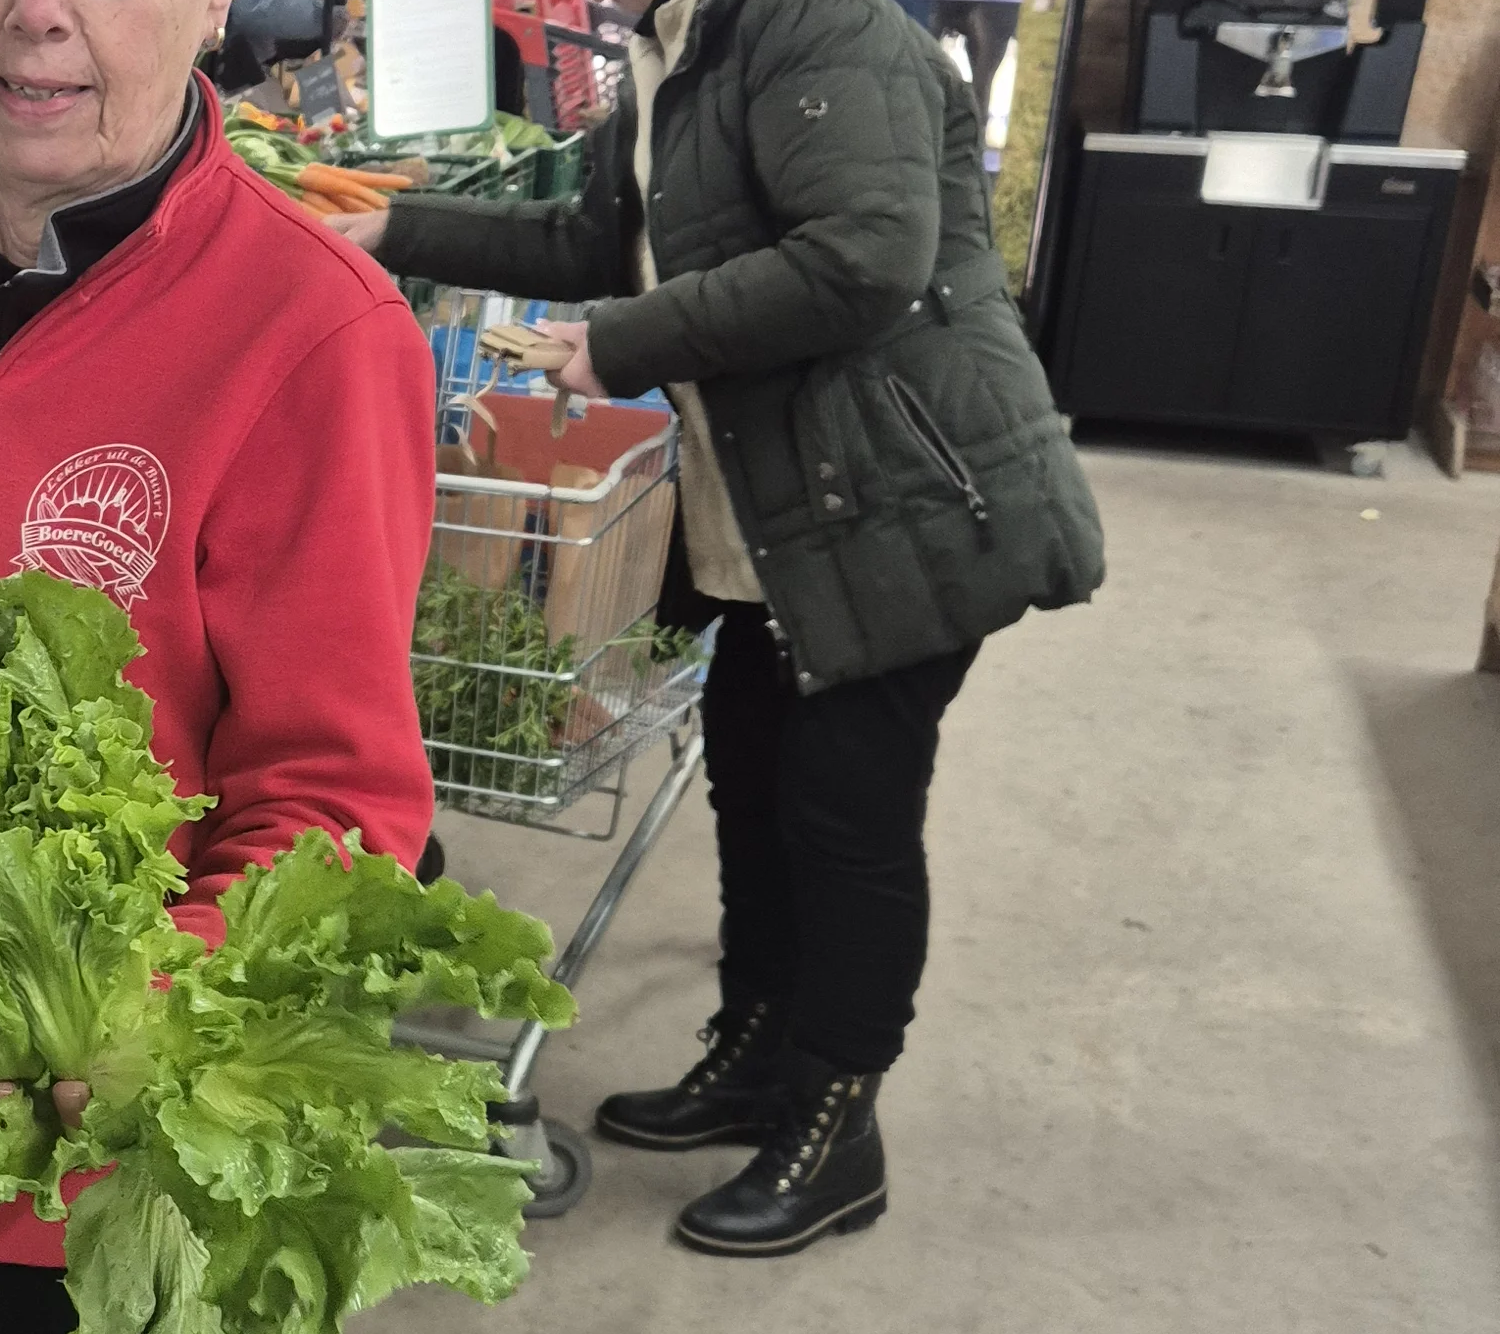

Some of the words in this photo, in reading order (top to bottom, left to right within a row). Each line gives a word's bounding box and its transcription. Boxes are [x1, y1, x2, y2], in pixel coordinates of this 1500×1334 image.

[45, 452, 103, 493] Lekker
[106, 450, 129, 460] uit
[130, 454, 147, 468] de
[145, 466, 164, 518] Buurt
[38, 525, 138, 566] BoereGoed
